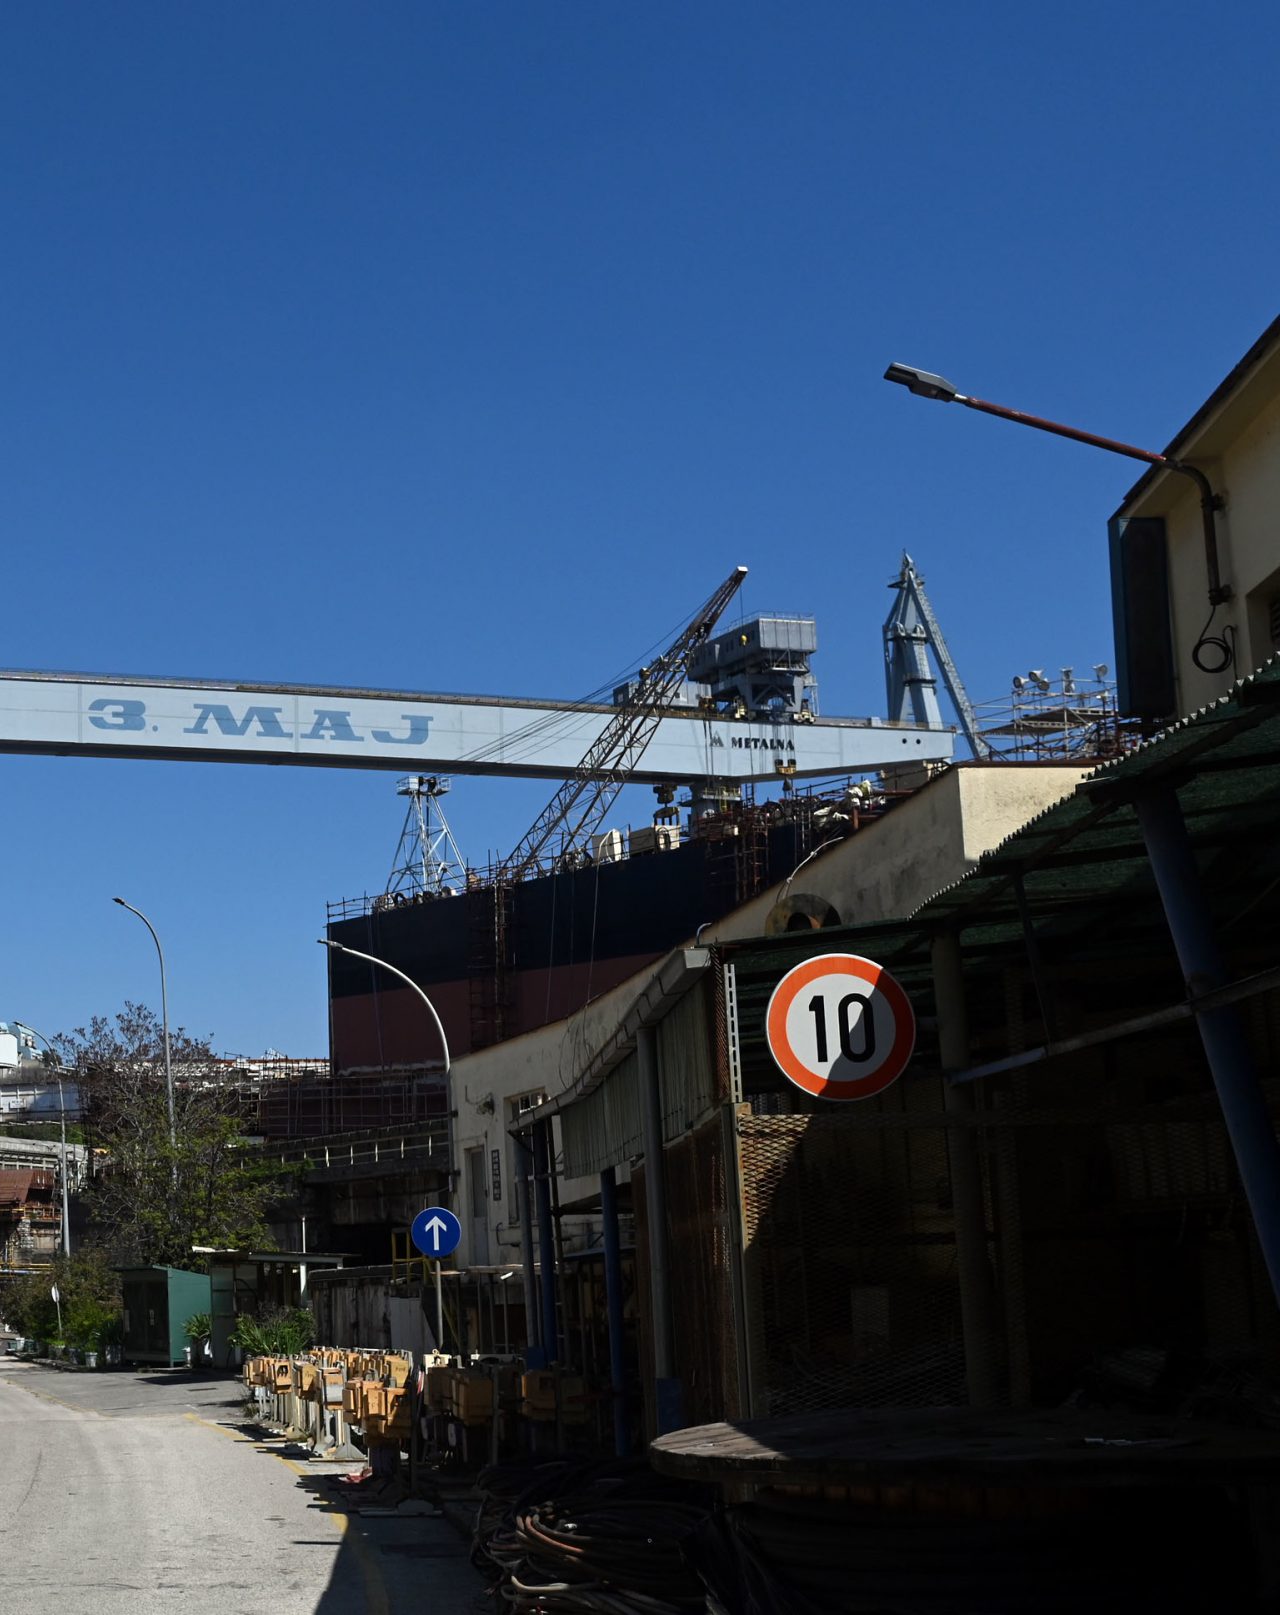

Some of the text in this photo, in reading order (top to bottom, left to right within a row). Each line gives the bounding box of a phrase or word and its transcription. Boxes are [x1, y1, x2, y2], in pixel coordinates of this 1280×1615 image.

[88, 698, 433, 744] 3. MAJ
[732, 737, 794, 750] METALNA
[809, 993, 875, 1062] 10
